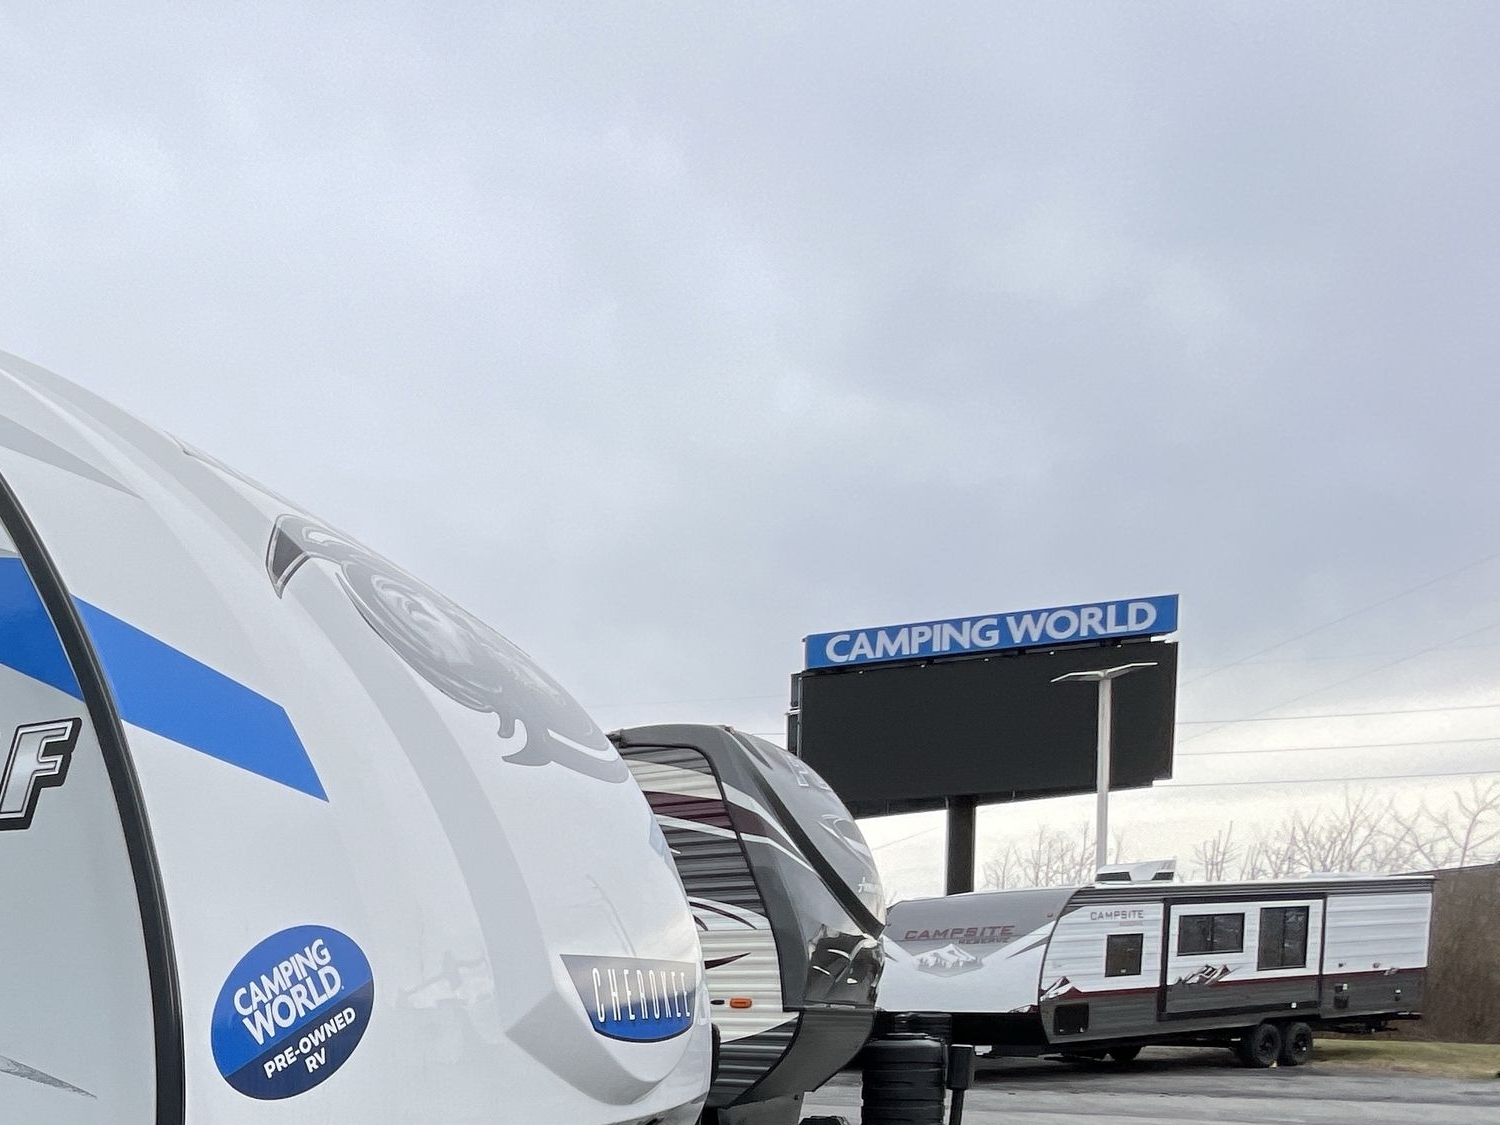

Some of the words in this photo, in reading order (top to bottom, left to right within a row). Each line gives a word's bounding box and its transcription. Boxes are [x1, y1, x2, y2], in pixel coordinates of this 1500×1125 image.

[825, 617, 1000, 663] CAMPING
[1005, 601, 1157, 644] WORLD
[904, 925, 1015, 940] CAMPSITE
[1090, 909, 1144, 921] CAMPSITE
[233, 938, 332, 1016] CAMPING
[242, 965, 342, 1046] WORLD
[592, 967, 691, 1023] CHEROKEE
[263, 1007, 356, 1079] PRE-OWNED
[304, 1047, 327, 1073] RV
